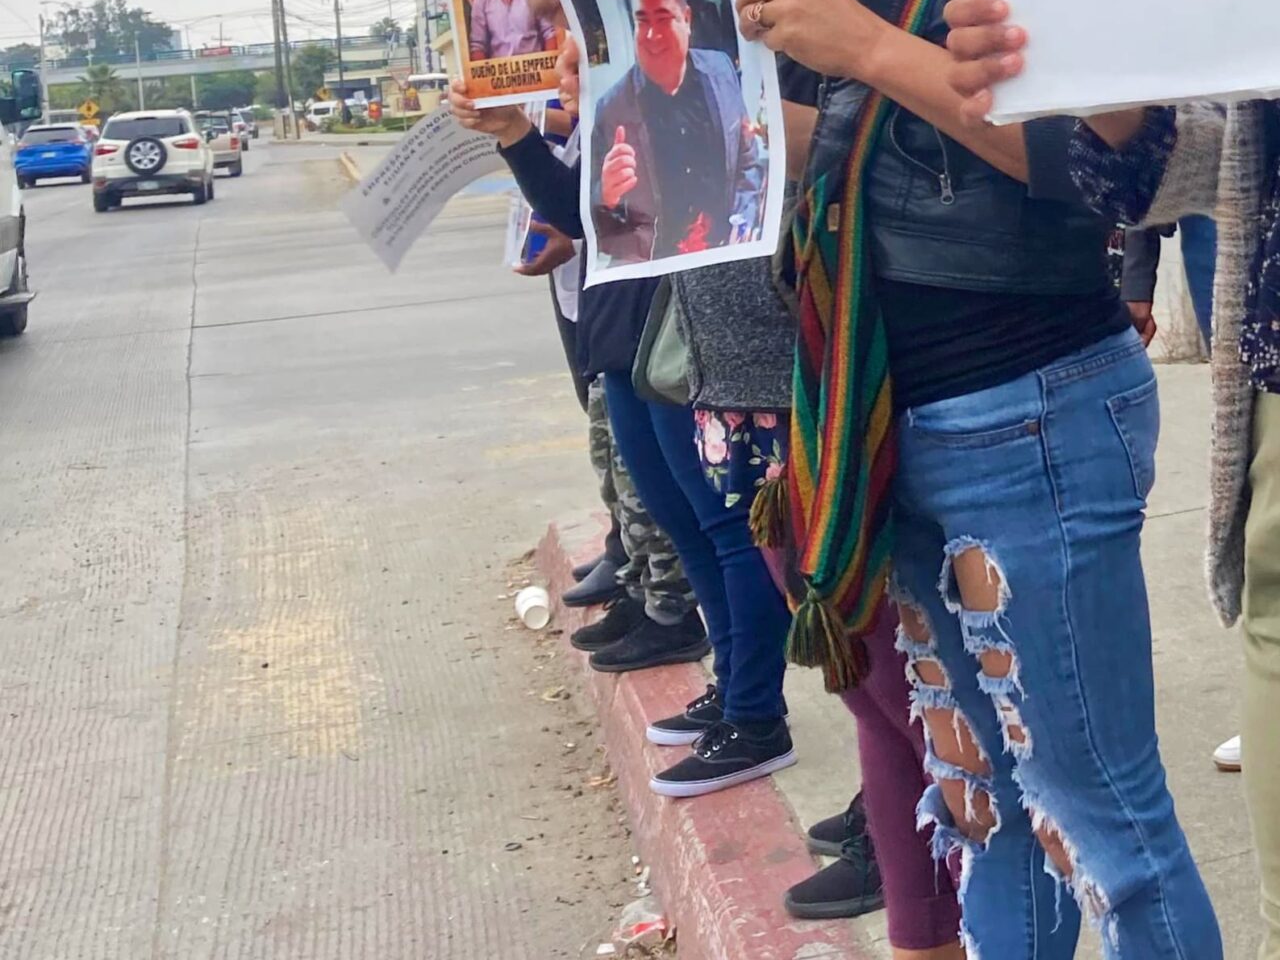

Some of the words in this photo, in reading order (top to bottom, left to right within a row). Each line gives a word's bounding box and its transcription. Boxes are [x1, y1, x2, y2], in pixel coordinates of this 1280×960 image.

[471, 62, 497, 79] DUEÑO
[497, 61, 510, 75] DE
[510, 60, 520, 74] LA
[490, 71, 542, 89] GOLONDRINA
